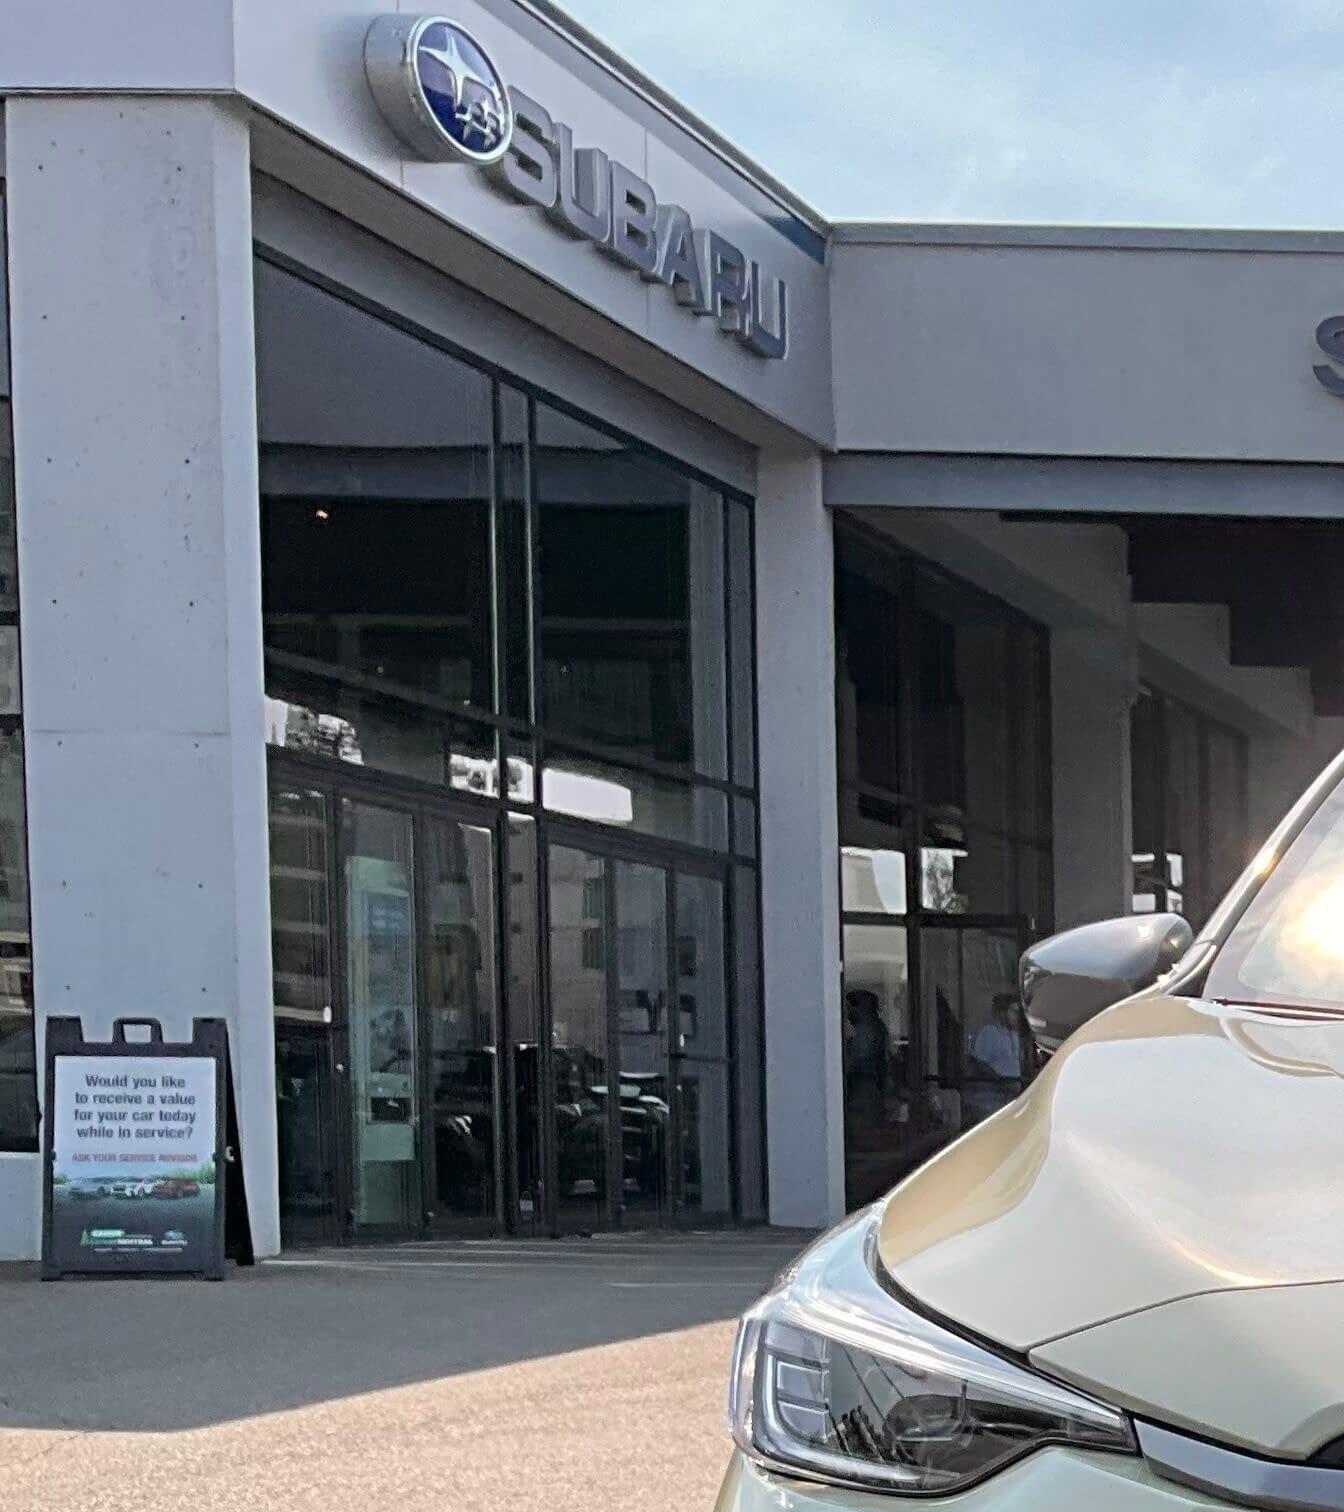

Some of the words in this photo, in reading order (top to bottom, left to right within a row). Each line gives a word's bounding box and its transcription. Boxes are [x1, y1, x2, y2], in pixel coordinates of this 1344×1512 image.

[500, 84, 790, 361] SUBARU
[85, 1074, 128, 1088] Would
[132, 1077, 157, 1090] you
[161, 1075, 185, 1088] like
[75, 1092, 88, 1104] to
[92, 1093, 142, 1104] receive
[146, 1095, 155, 1105] a
[160, 1093, 196, 1105] value
[74, 1109, 93, 1121] for
[97, 1111, 128, 1123] your
[132, 1111, 154, 1121] car
[159, 1109, 196, 1123] today
[76, 1126, 114, 1138] while
[118, 1126, 131, 1138] in
[135, 1126, 193, 1139] service?
[72, 1153, 91, 1162] ASK
[93, 1153, 117, 1162] YOUR
